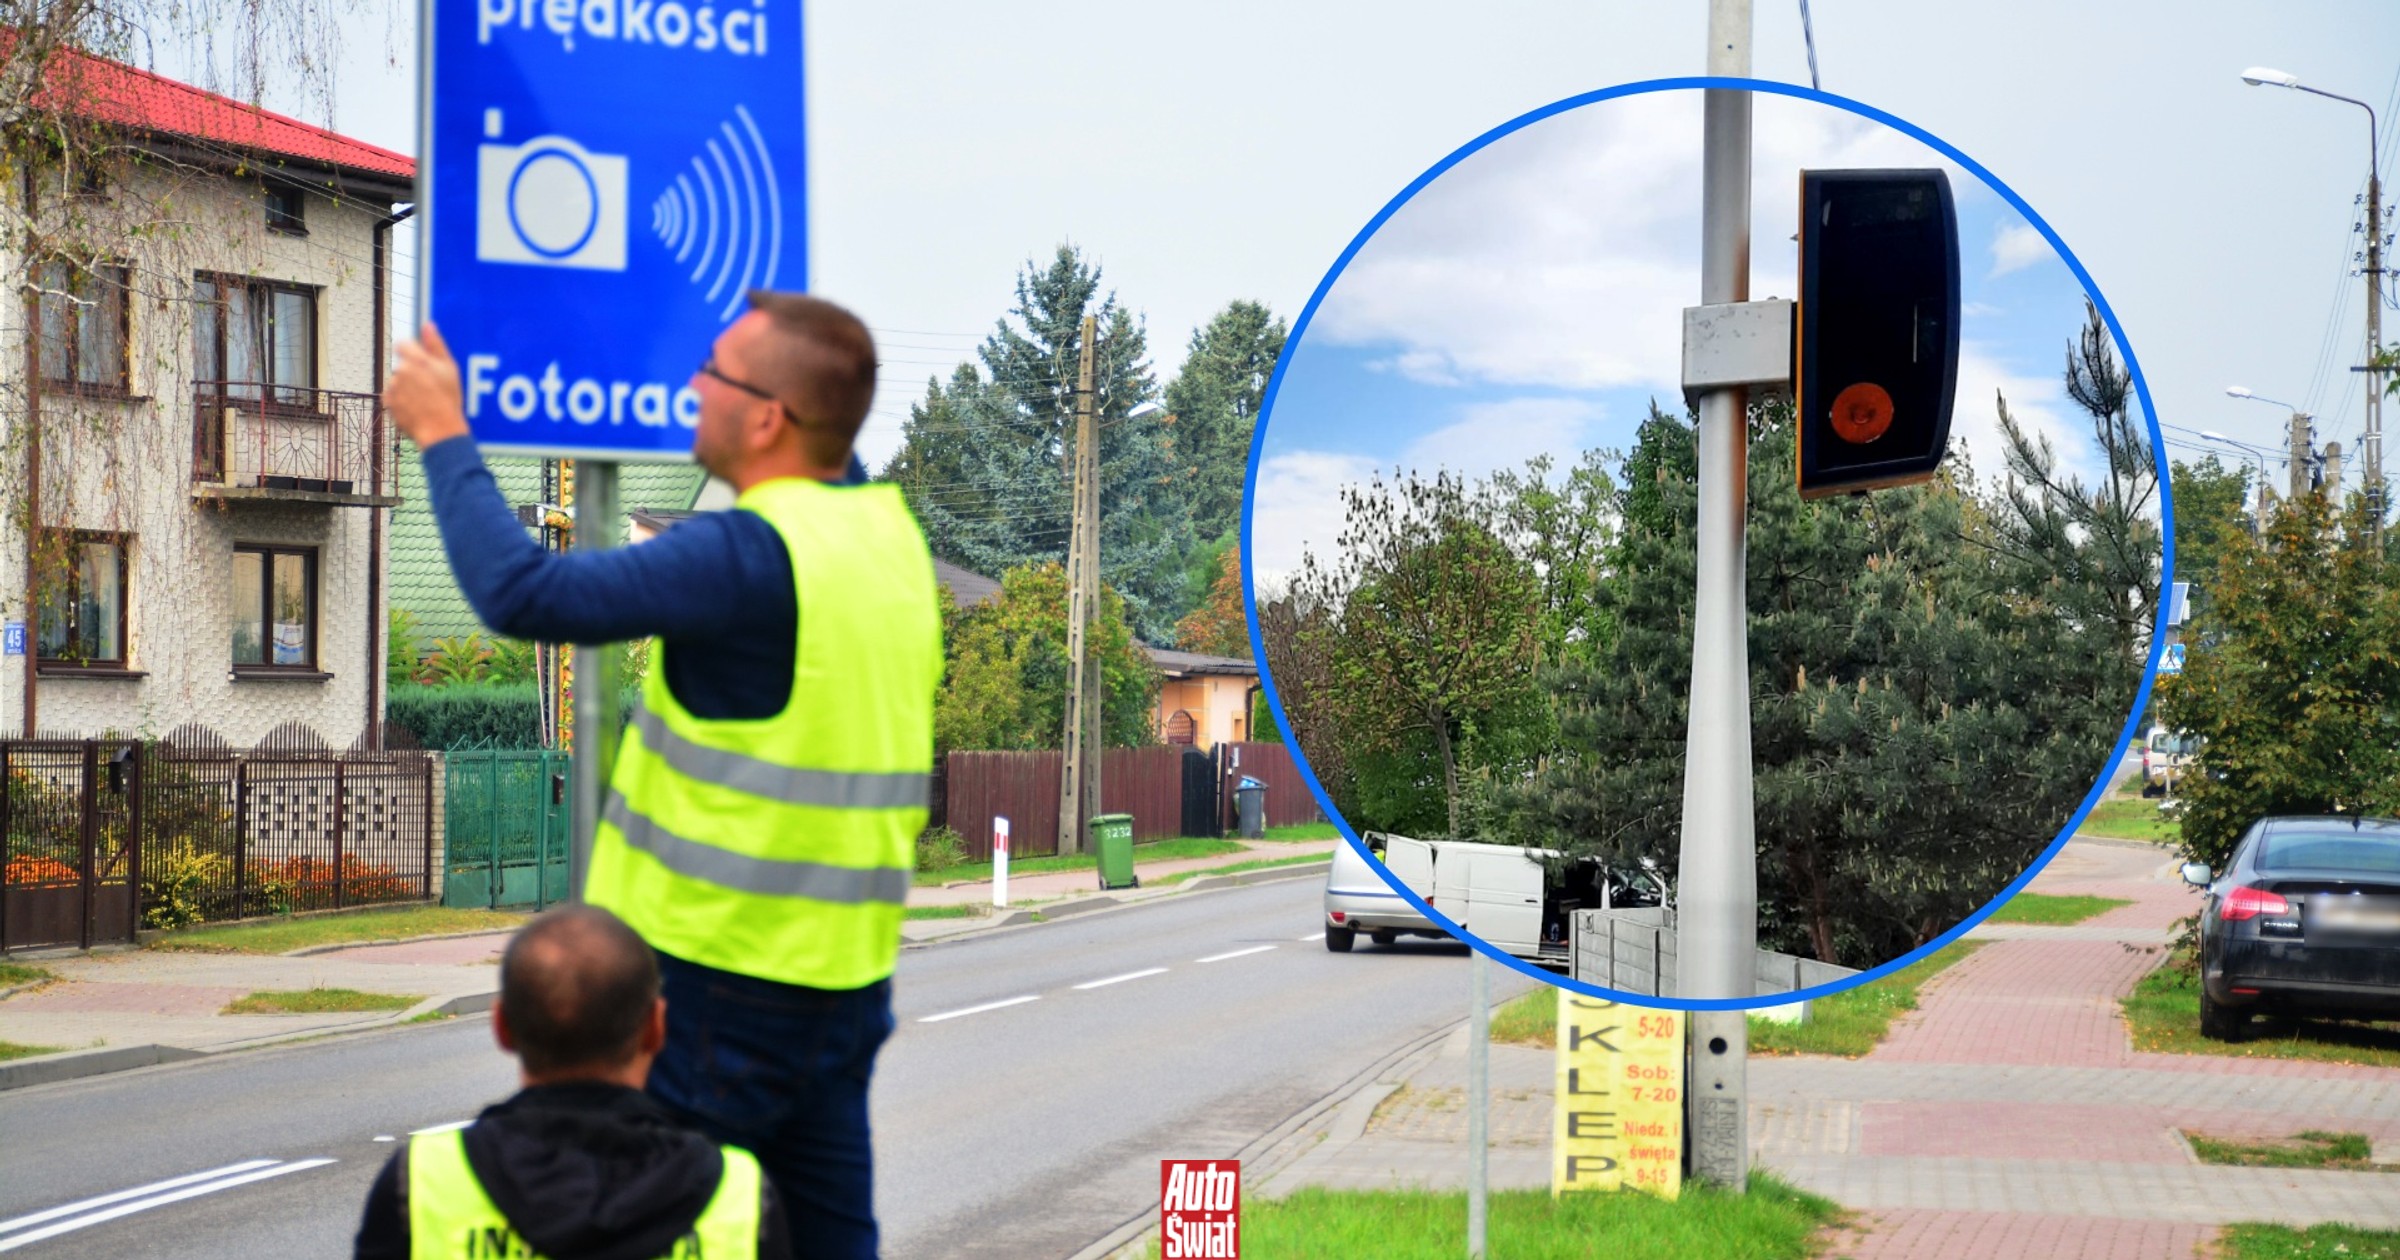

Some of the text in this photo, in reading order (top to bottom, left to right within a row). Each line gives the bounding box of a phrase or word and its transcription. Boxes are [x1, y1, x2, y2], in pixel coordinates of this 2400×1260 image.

[8, 629, 22, 648] 45
[1638, 1016, 1675, 1038] 5-20
[1627, 1065, 1676, 1080] Sob:
[1566, 1000, 1623, 1182] KLEP
[1631, 1087, 1677, 1102] 7-20
[1623, 1122, 1679, 1137] Niedz. i
[1629, 1144, 1676, 1163] święta
[1636, 1168, 1668, 1184] 9-15
